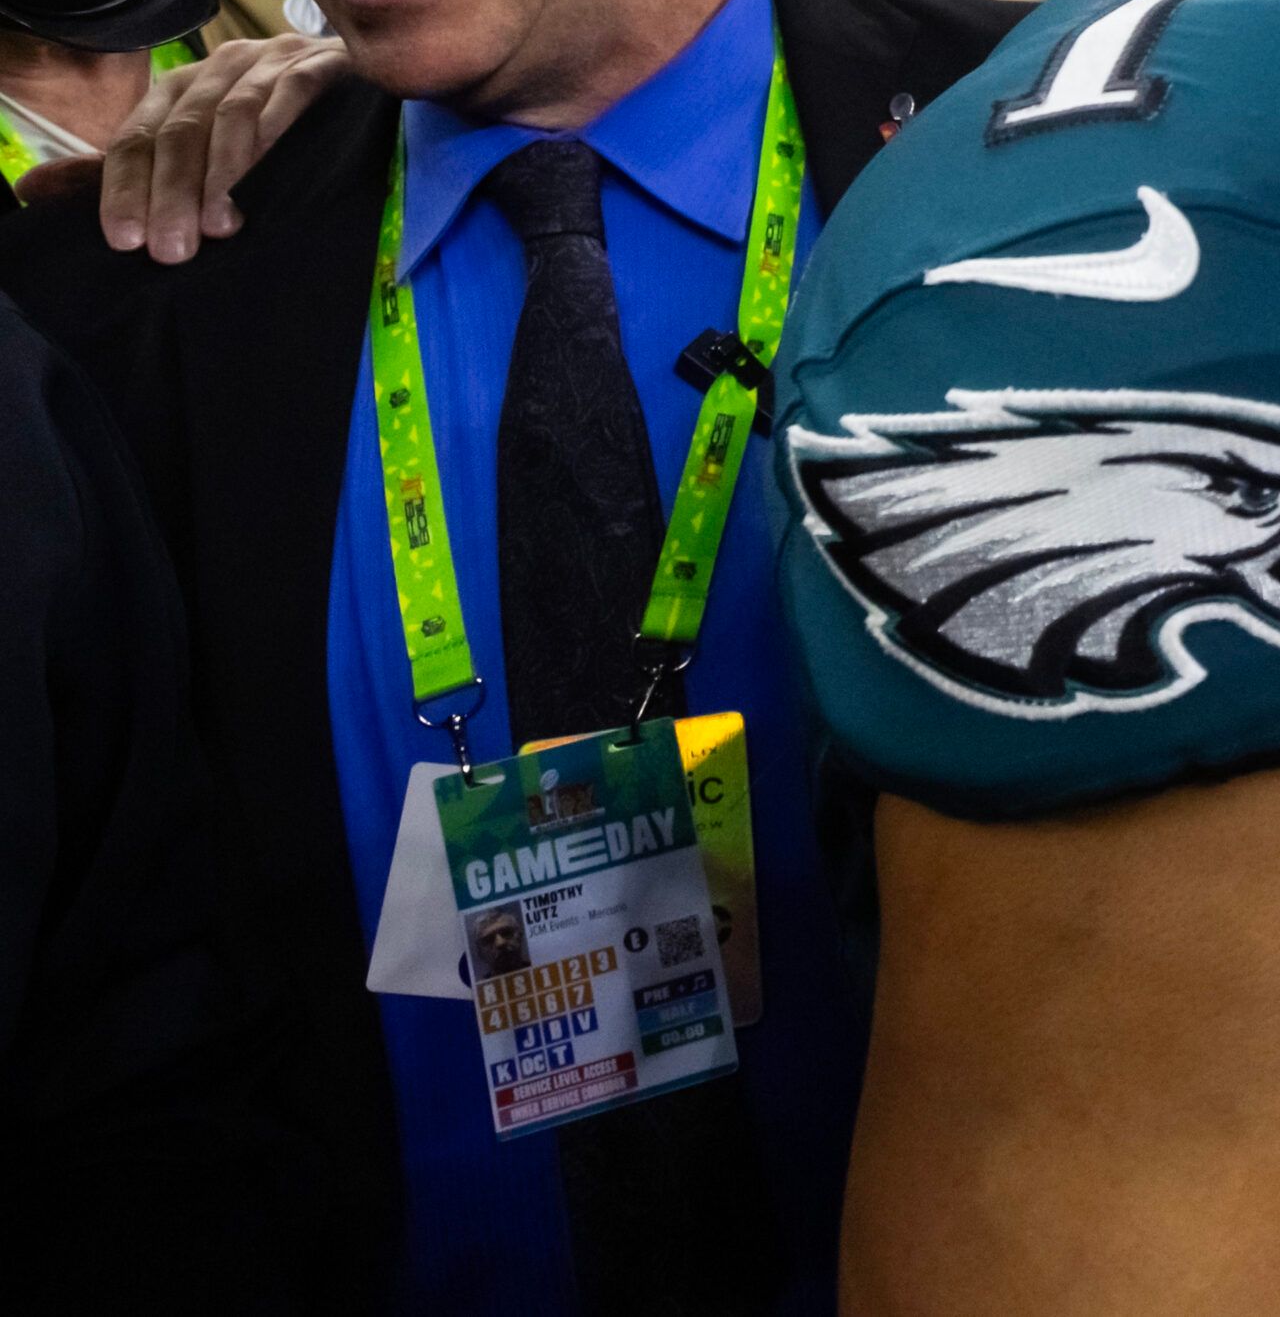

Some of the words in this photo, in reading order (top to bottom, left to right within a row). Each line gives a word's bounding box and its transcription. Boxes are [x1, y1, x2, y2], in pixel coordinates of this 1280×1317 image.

[523, 884, 583, 911] TIMOTHY
[525, 905, 558, 925] LUTZ
[550, 915, 579, 932] Events
[539, 968, 551, 987] 1
[569, 959, 581, 978] 2
[598, 952, 609, 971] 3
[489, 1011, 501, 1029] 4
[518, 1002, 531, 1021] 5
[573, 985, 585, 1006] 7
[523, 1029, 535, 1048] J
[577, 1011, 591, 1031] V
[497, 1064, 511, 1082] K
[552, 1046, 567, 1065] T
[513, 1082, 552, 1102] SERVICE
[553, 1070, 582, 1089] LEVEL
[583, 1058, 618, 1079] ACCESS
